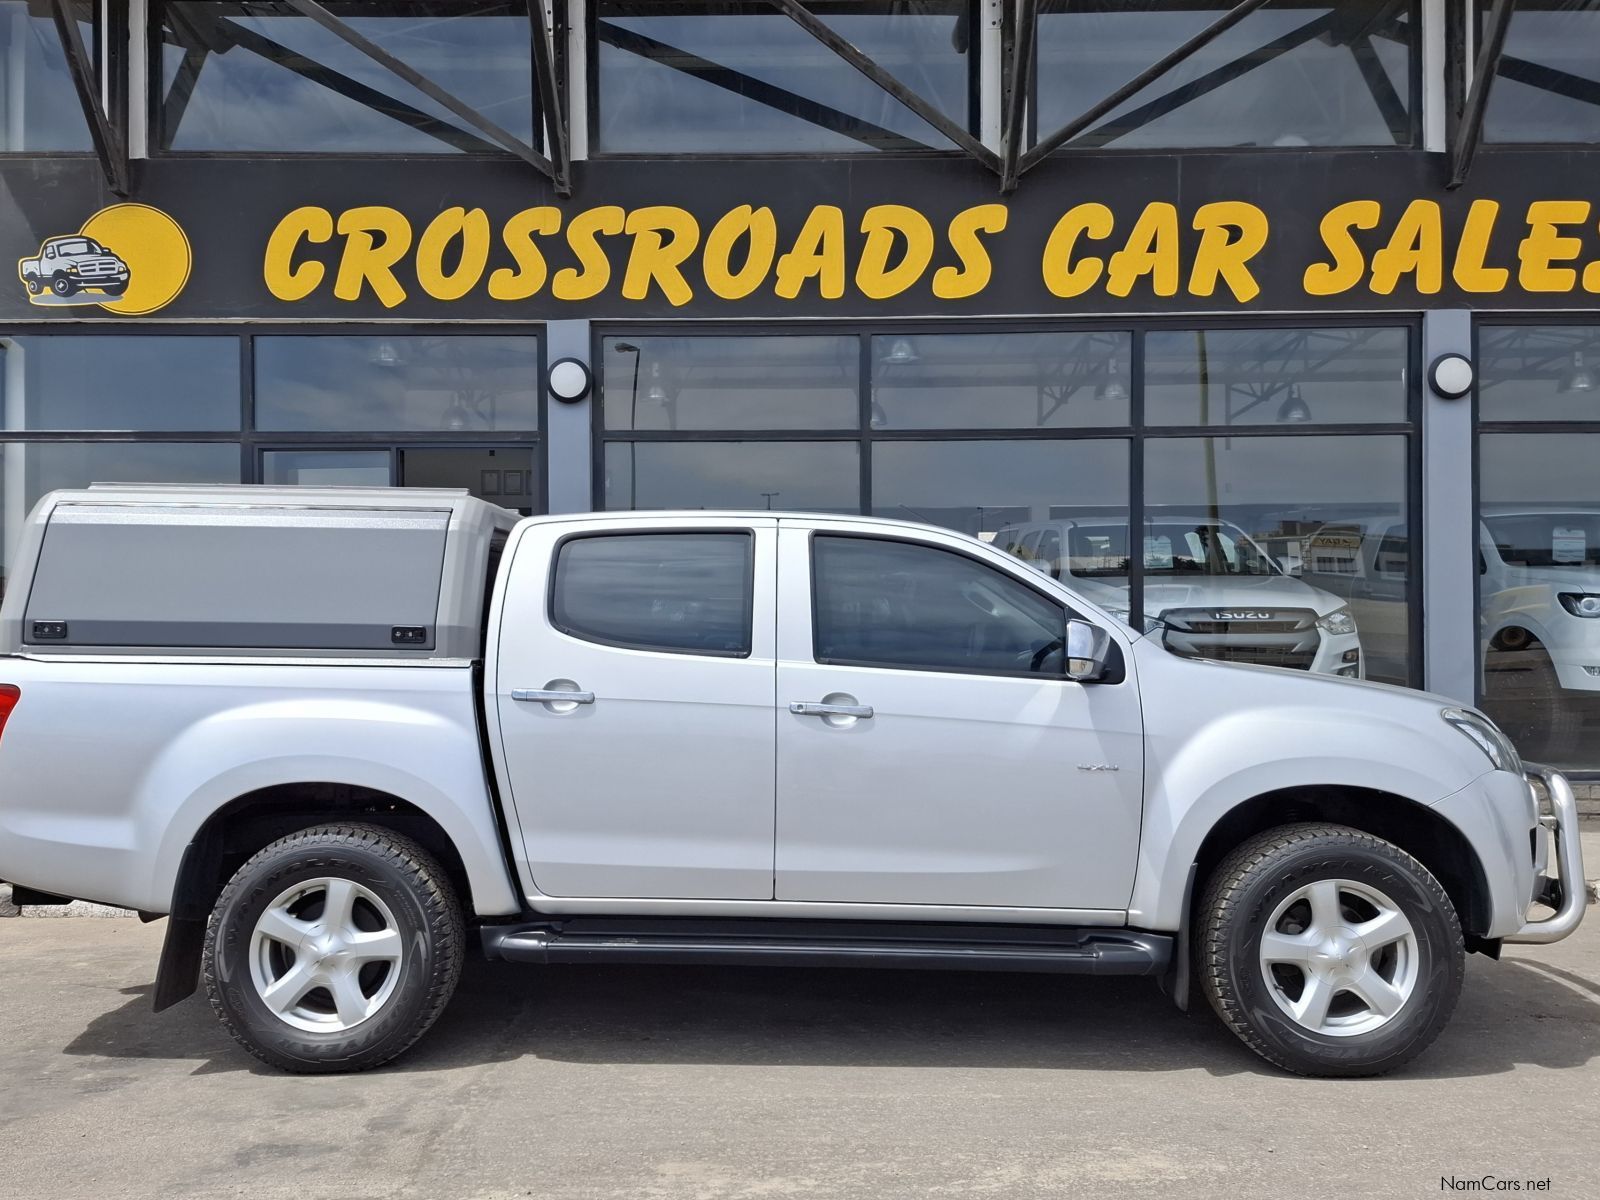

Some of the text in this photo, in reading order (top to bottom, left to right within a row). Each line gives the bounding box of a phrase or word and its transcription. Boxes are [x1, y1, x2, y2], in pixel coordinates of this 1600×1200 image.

[263, 198, 1600, 308] CROSSROADS CAR SALE
[1215, 610, 1270, 619] ISUZU
